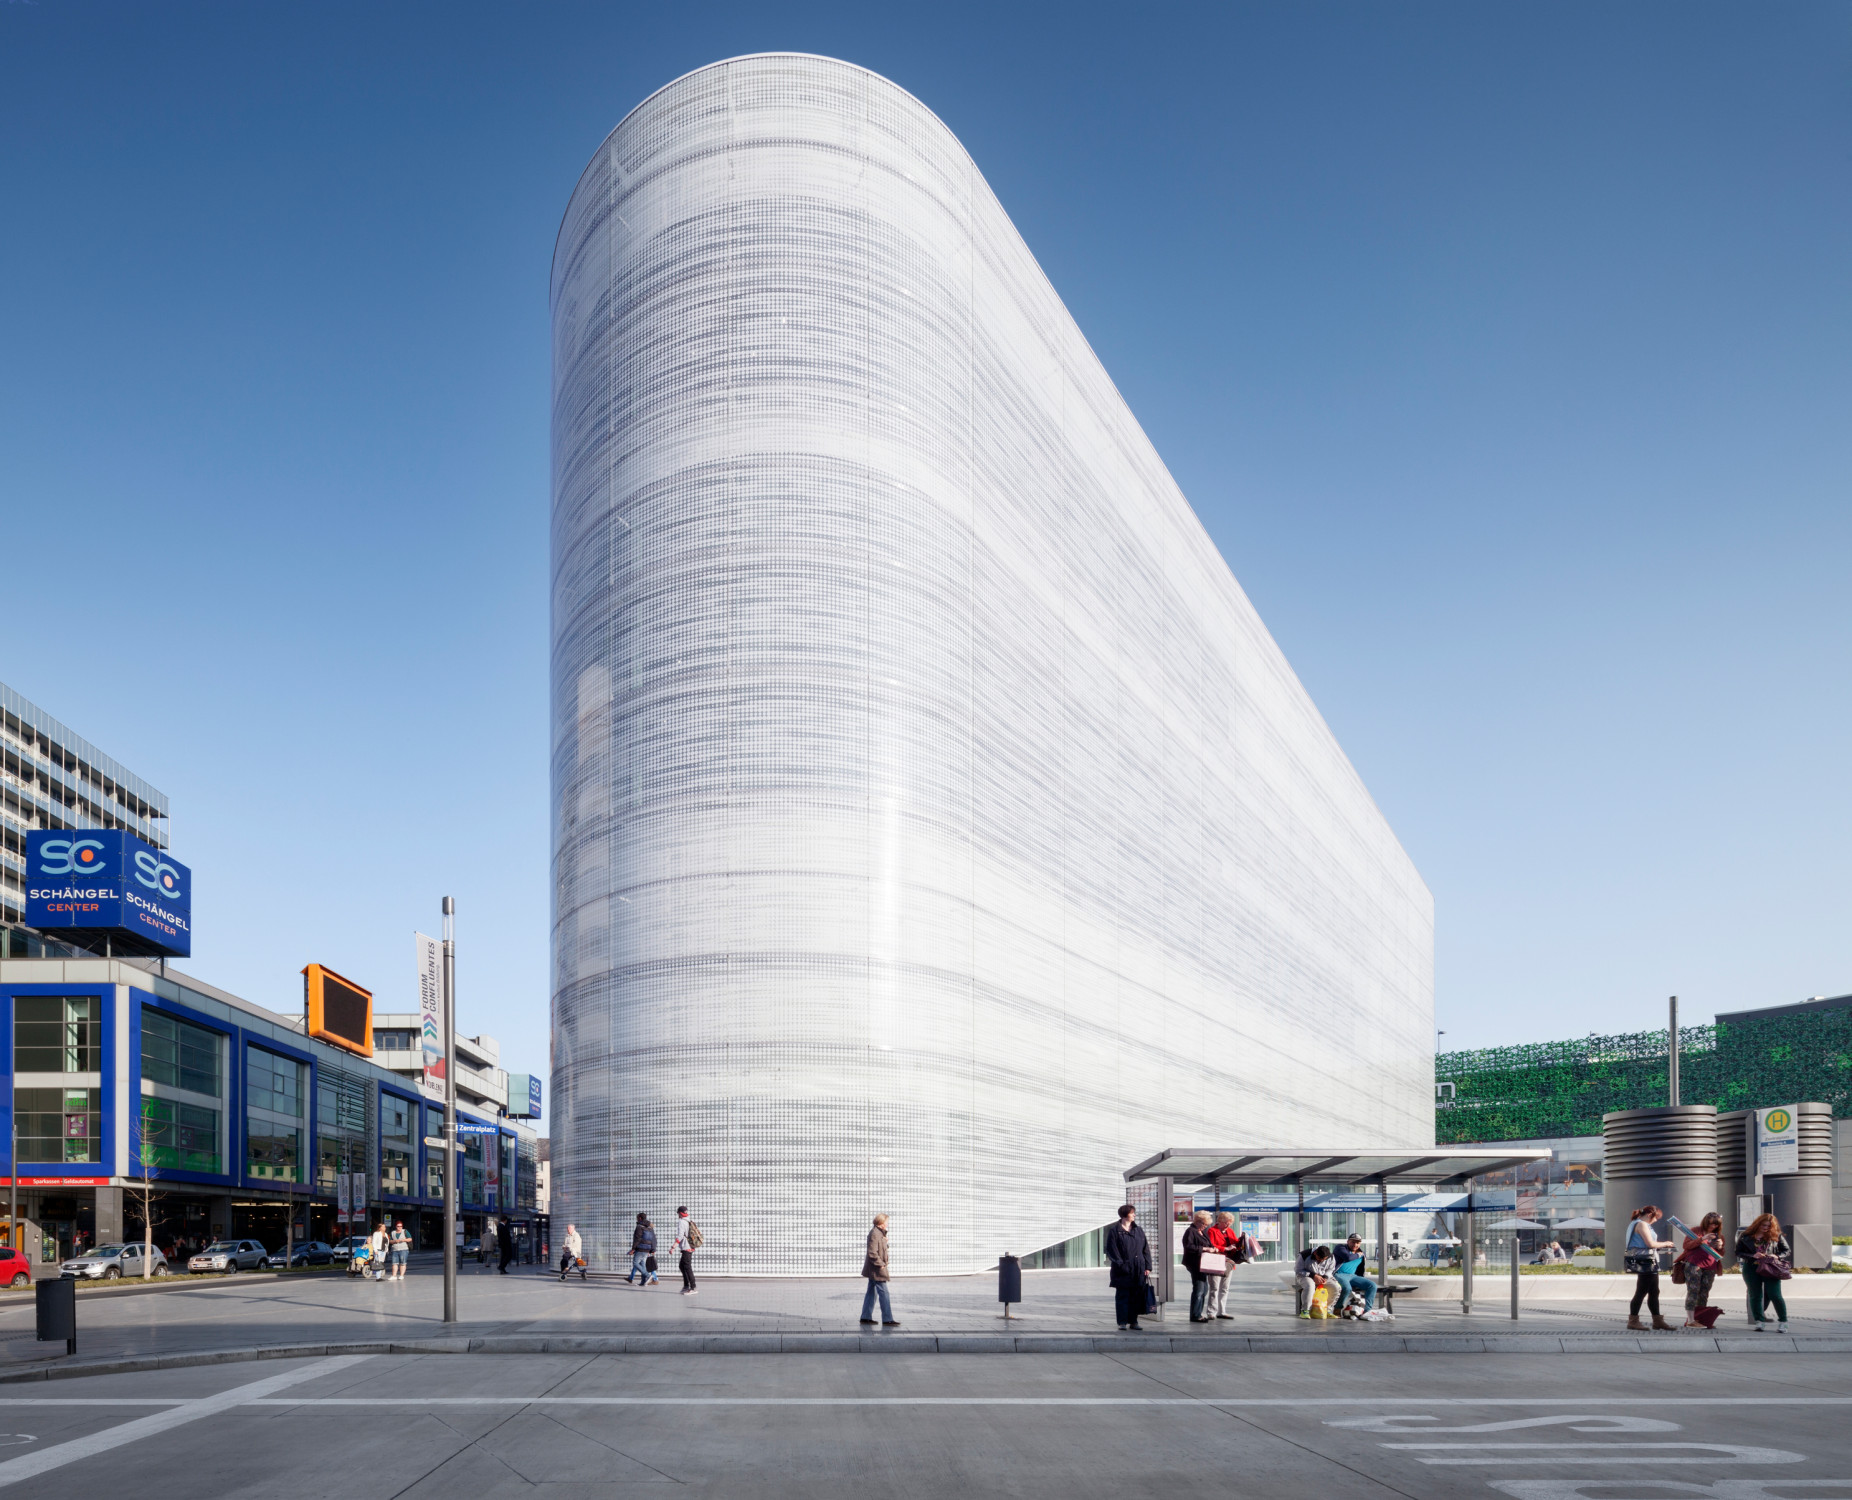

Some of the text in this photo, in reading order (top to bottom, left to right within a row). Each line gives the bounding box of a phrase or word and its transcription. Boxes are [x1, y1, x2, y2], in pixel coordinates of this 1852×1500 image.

[40, 839, 106, 874] SC
[134, 850, 181, 899] SC
[29, 887, 119, 899] SCHÄNGEL
[47, 903, 99, 912] CENTER
[126, 892, 189, 931] SCHÄNGEL
[139, 912, 177, 936] CENTER
[428, 941, 436, 1012] CONFLUENTES
[459, 1124, 496, 1134] Zentralplatz
[1773, 1114, 1783, 1128] H
